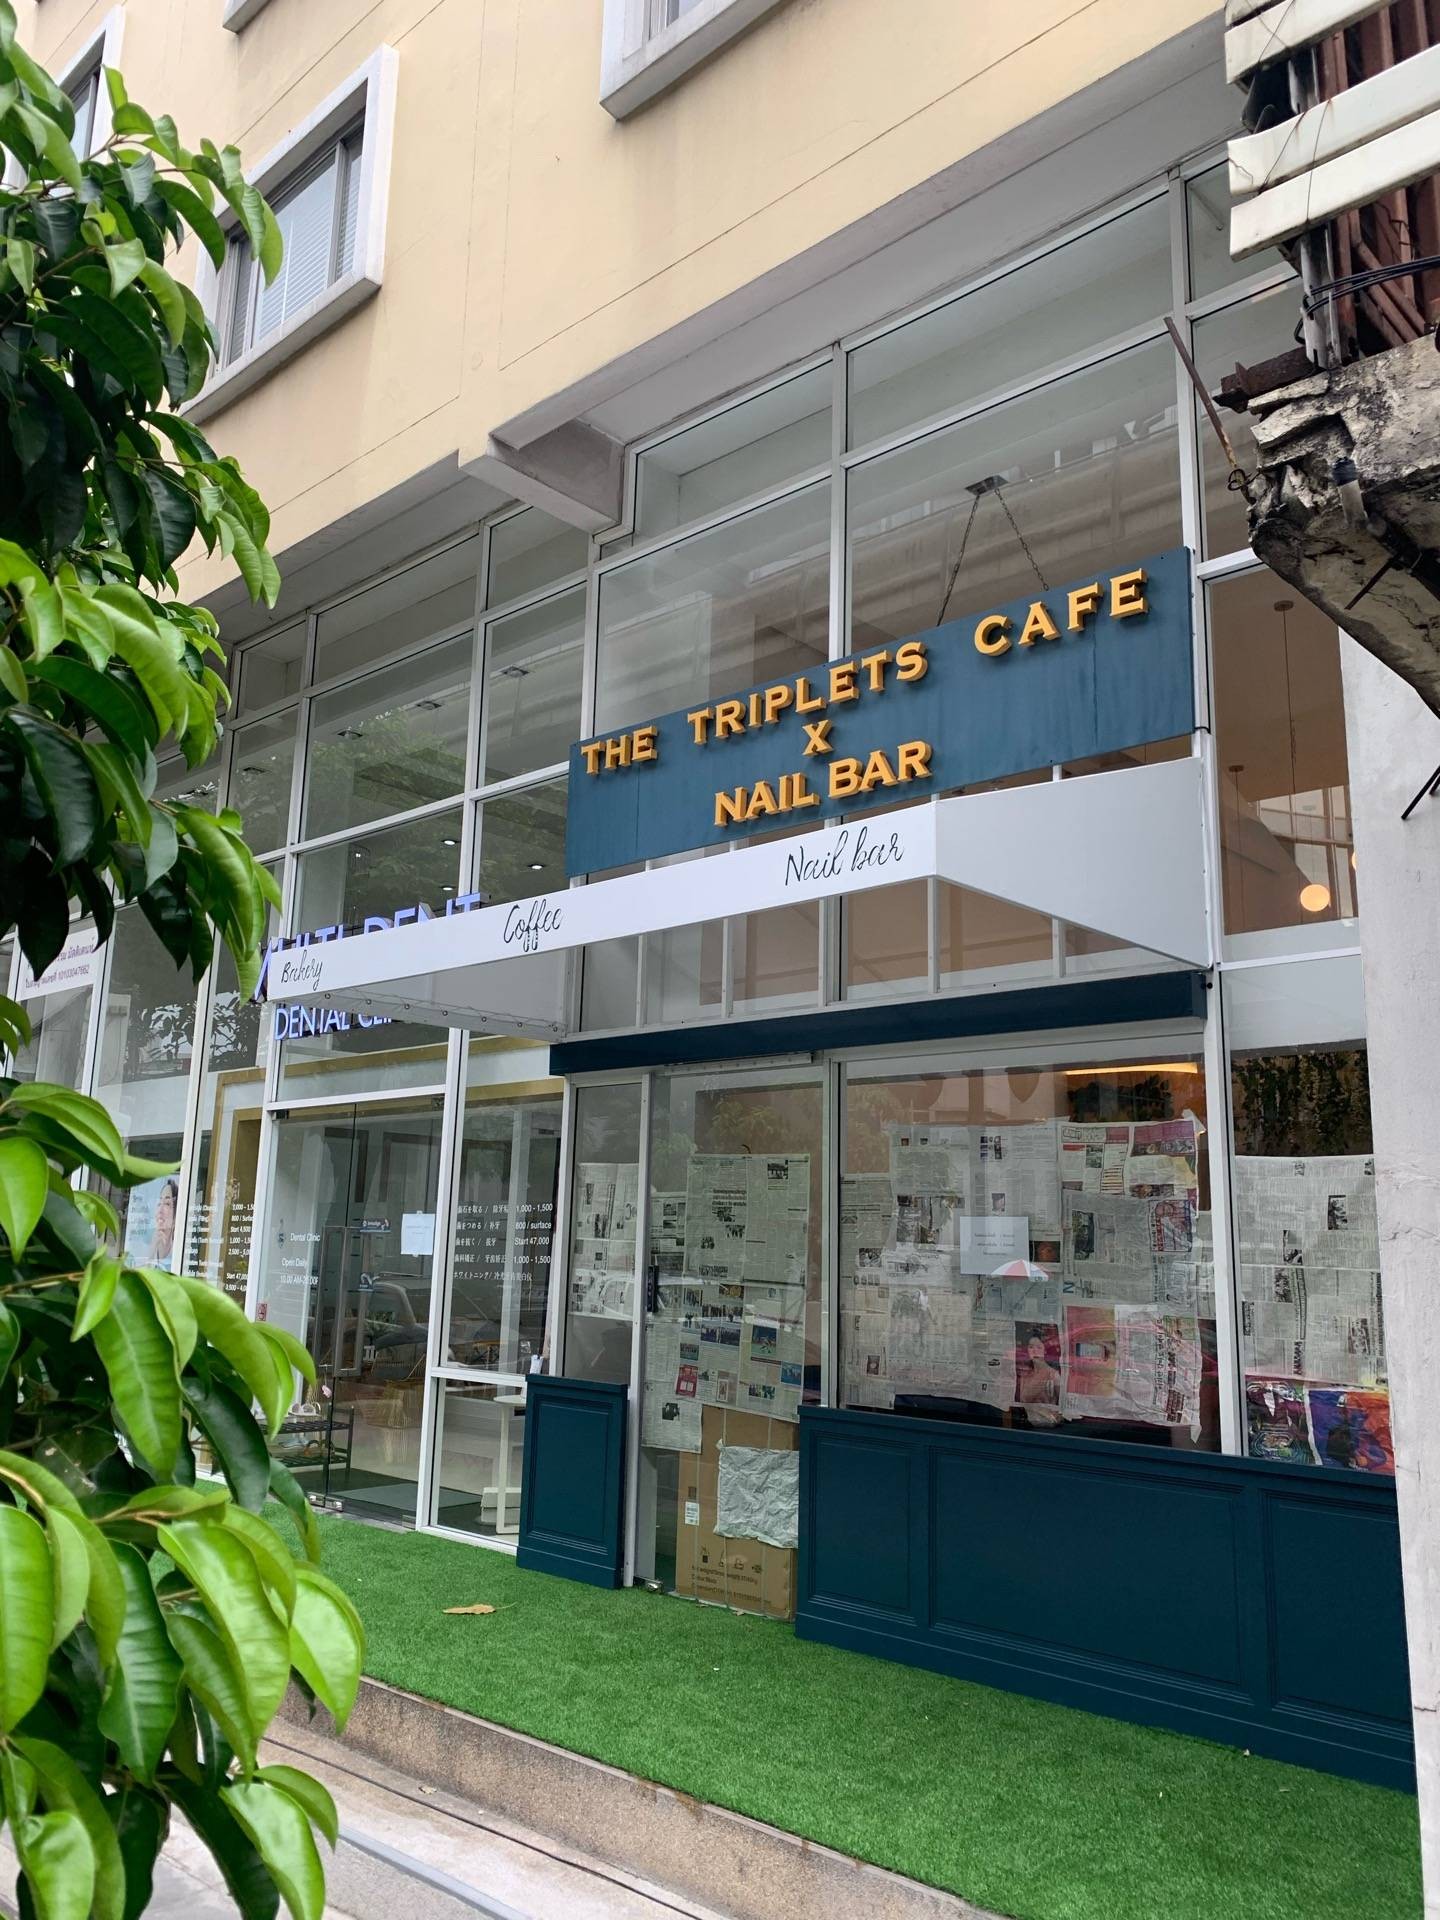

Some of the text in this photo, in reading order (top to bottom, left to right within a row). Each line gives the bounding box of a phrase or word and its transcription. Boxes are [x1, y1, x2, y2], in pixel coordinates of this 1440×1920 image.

[581, 568, 1149, 775] THE TRIPLETS CAFE
[802, 719, 833, 757] X
[714, 740, 932, 827] NAIL BAR
[785, 825, 905, 886] Nail bar
[503, 898, 562, 952] Coffee
[281, 949, 323, 991] Bakery
[516, 1203, 531, 1213] 1,000
[537, 1203, 553, 1212] 1,500
[290, 1232, 320, 1242] Dental Clinic
[530, 1221, 552, 1230] surface
[514, 1237, 529, 1246] Start
[281, 1258, 295, 1267] Open
[513, 1255, 530, 1264] 1,000
[534, 1255, 552, 1264] 1,500
